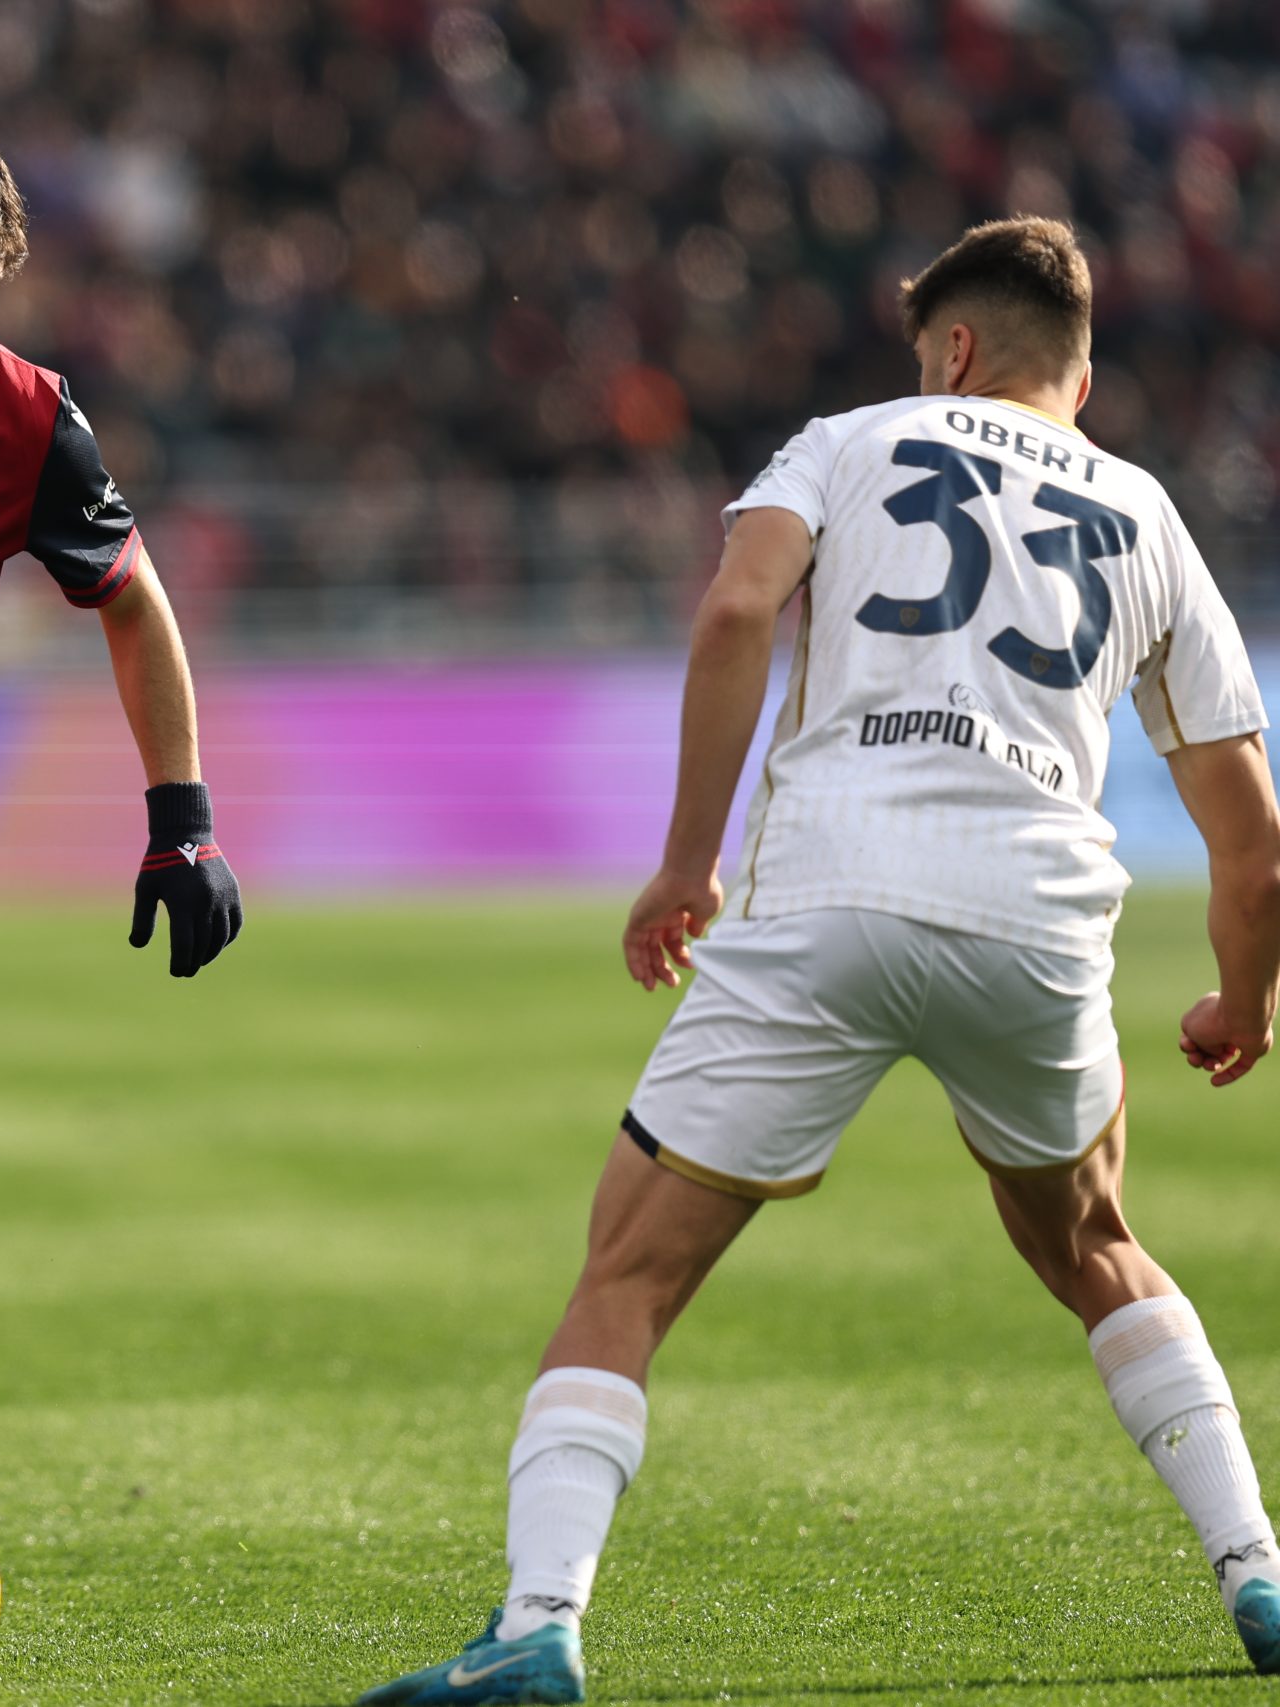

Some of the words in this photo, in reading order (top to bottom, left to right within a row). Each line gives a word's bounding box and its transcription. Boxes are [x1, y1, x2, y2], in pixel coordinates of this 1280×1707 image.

[946, 410, 1104, 483] OBERT
[854, 438, 1138, 690] 33
[859, 710, 975, 747] DOPPIO
